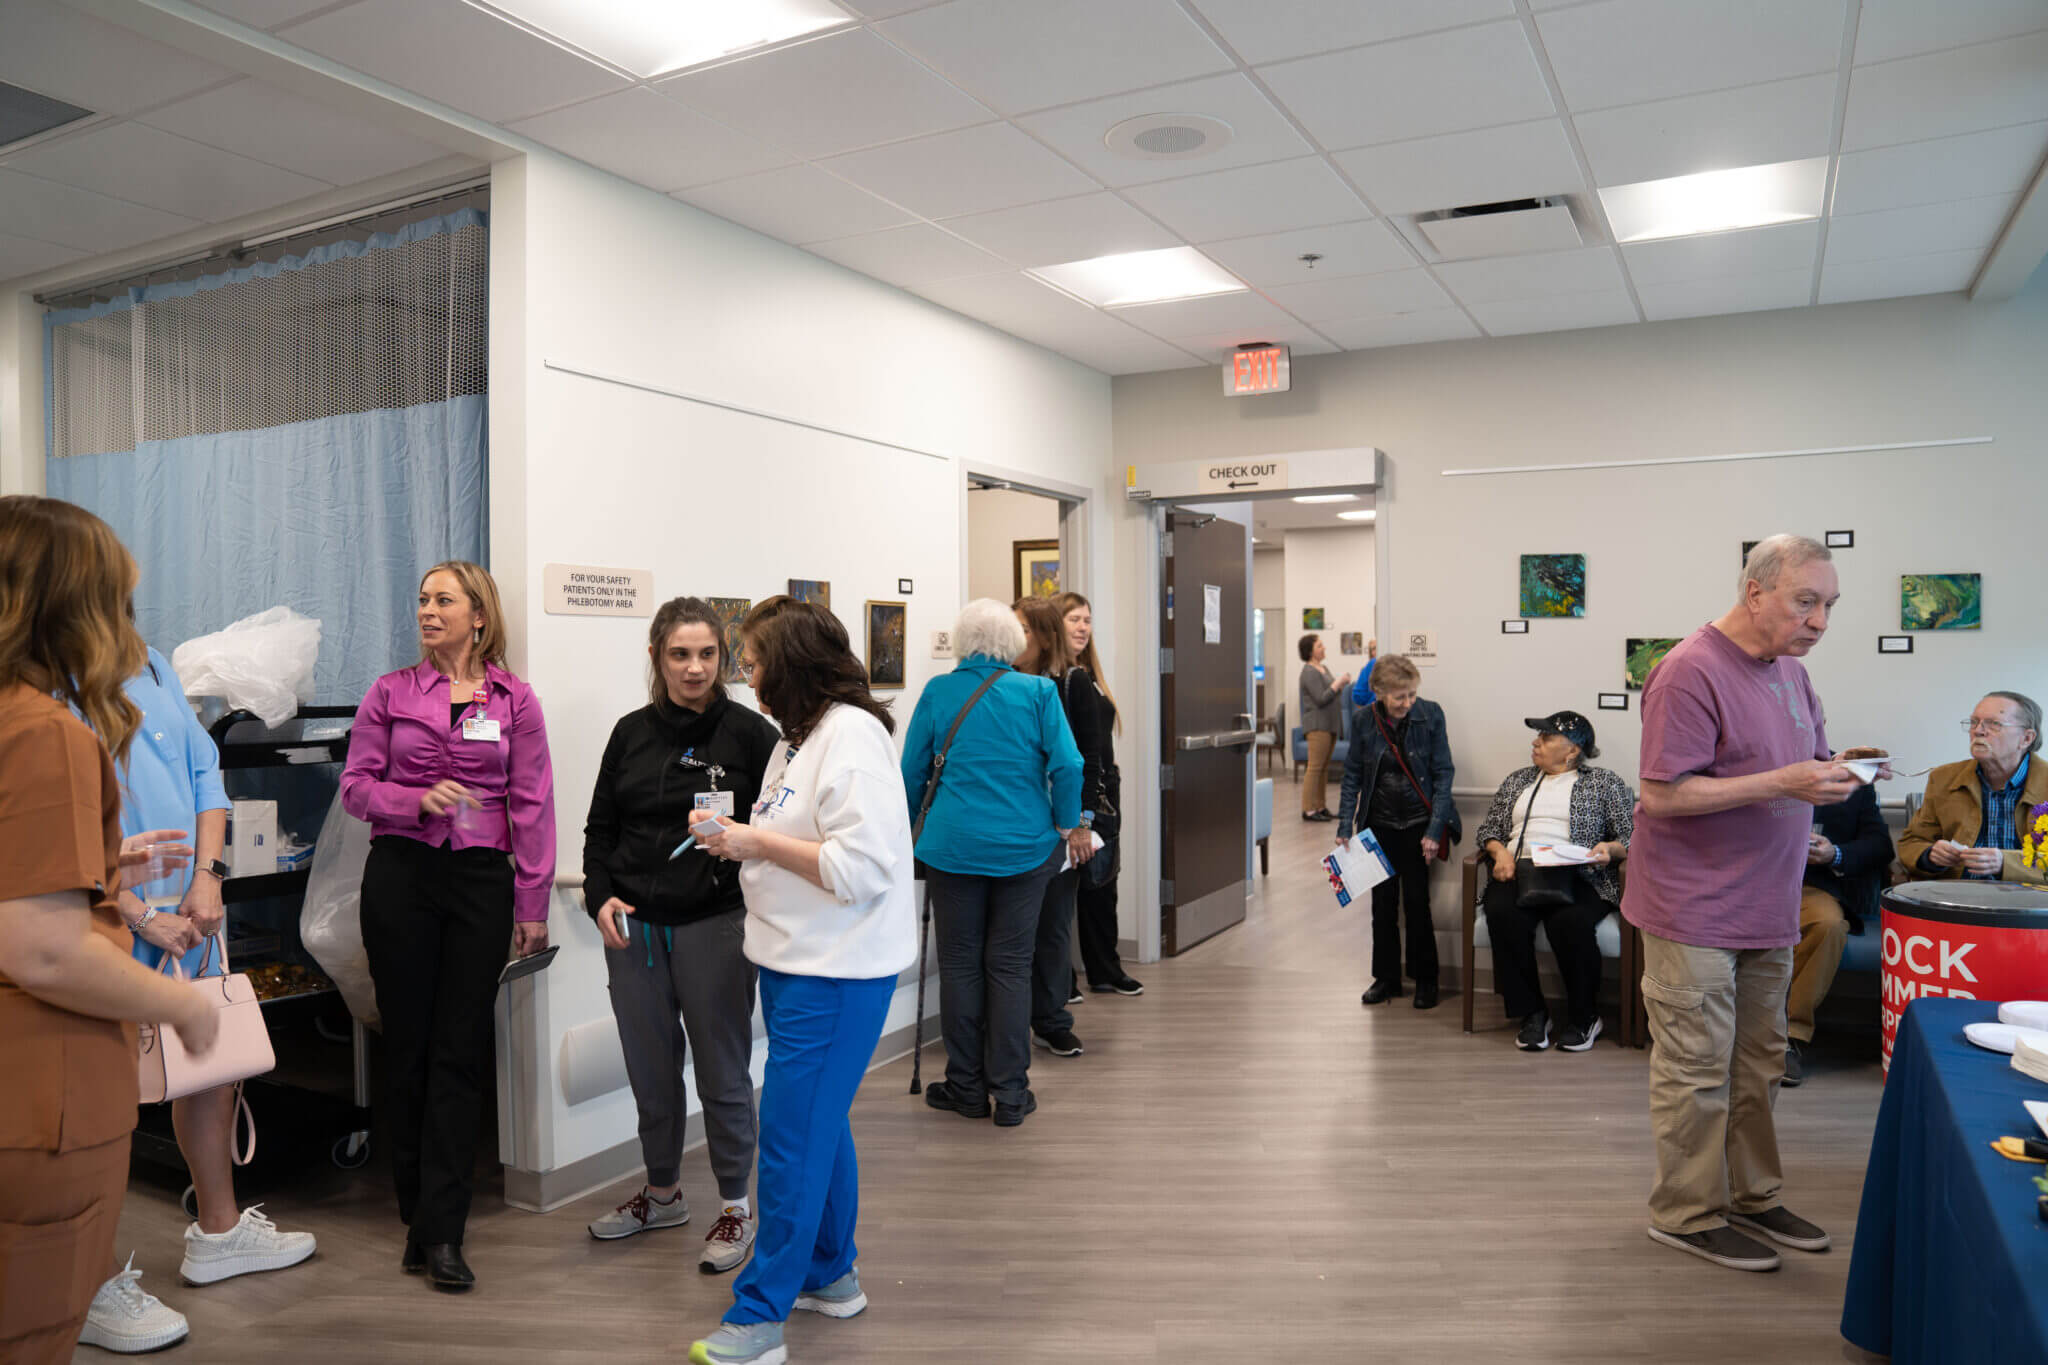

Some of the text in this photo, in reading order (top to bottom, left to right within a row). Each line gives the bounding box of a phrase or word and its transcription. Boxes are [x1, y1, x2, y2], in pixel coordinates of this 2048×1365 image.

[1233, 348, 1281, 392] EXIT
[1208, 464, 1277, 480] CHECK OUT
[571, 573, 631, 585] FOR YOUR SAFETY
[563, 584, 637, 597] PATIENTS ONLY IN THE
[567, 597, 633, 608] PHLEBOTOMY AREA
[1881, 927, 1979, 983] OCK
